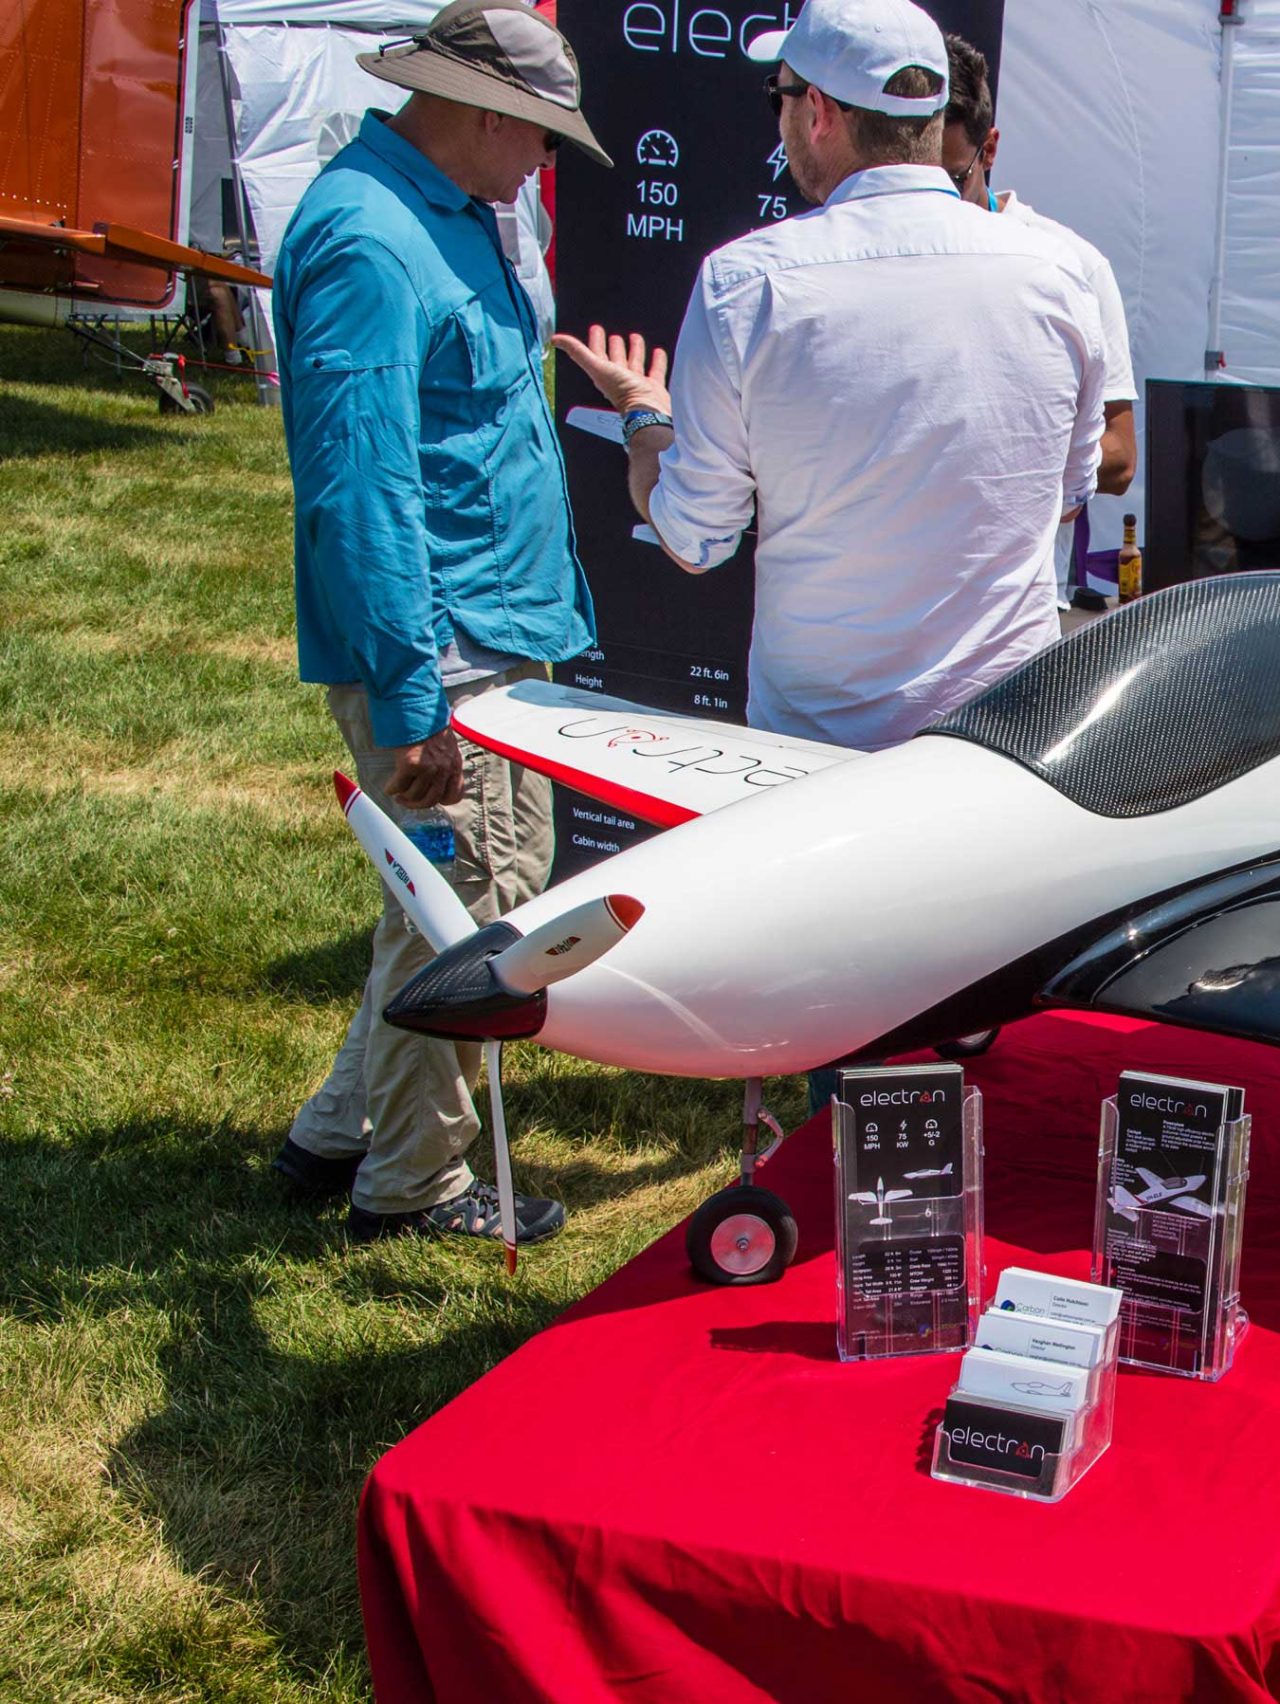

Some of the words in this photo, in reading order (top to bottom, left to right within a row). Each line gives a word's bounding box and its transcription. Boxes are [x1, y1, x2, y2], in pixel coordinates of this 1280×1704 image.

[623, 0, 798, 58] elect
[636, 180, 678, 206] 150
[758, 194, 788, 219] 75
[626, 213, 684, 242] MPH
[577, 650, 605, 661] ength
[575, 673, 603, 689] Height
[690, 665, 702, 678] 22
[703, 667, 713, 679] ft.
[714, 669, 730, 681] 6in
[694, 694, 701, 705] 8
[701, 695, 712, 707] ft.
[714, 697, 728, 709] 1in
[572, 807, 602, 824] Vertical
[603, 812, 616, 827] tail
[617, 819, 635, 831] area
[572, 834, 595, 849] Cabin
[597, 839, 620, 853] width
[860, 1088, 946, 1107] electron
[1129, 1091, 1208, 1119] electron
[951, 1426, 1045, 1461] electron
